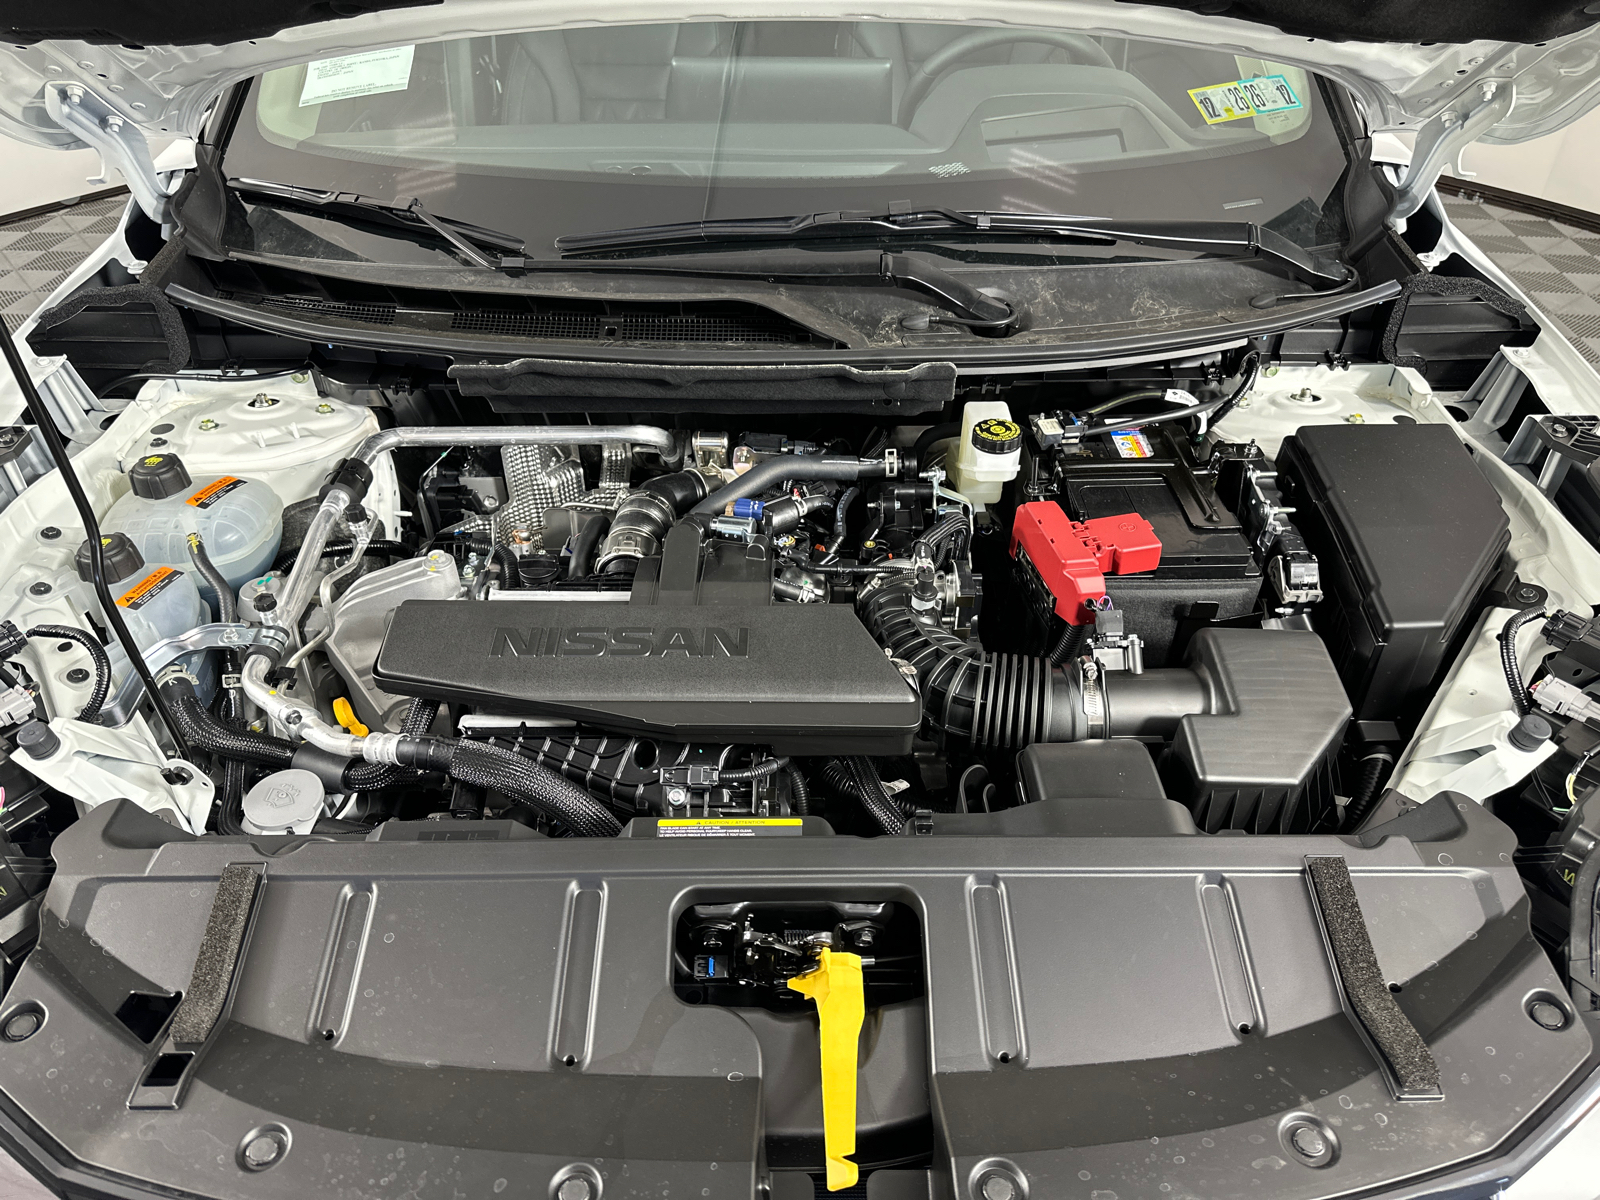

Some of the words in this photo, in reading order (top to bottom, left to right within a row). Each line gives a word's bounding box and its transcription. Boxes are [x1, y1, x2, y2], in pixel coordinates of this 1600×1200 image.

[1227, 86, 1250, 111] 26
[1243, 84, 1266, 108] 26
[1276, 84, 1296, 105] 12
[1199, 96, 1221, 118] 12
[489, 627, 749, 658] NISSAN
